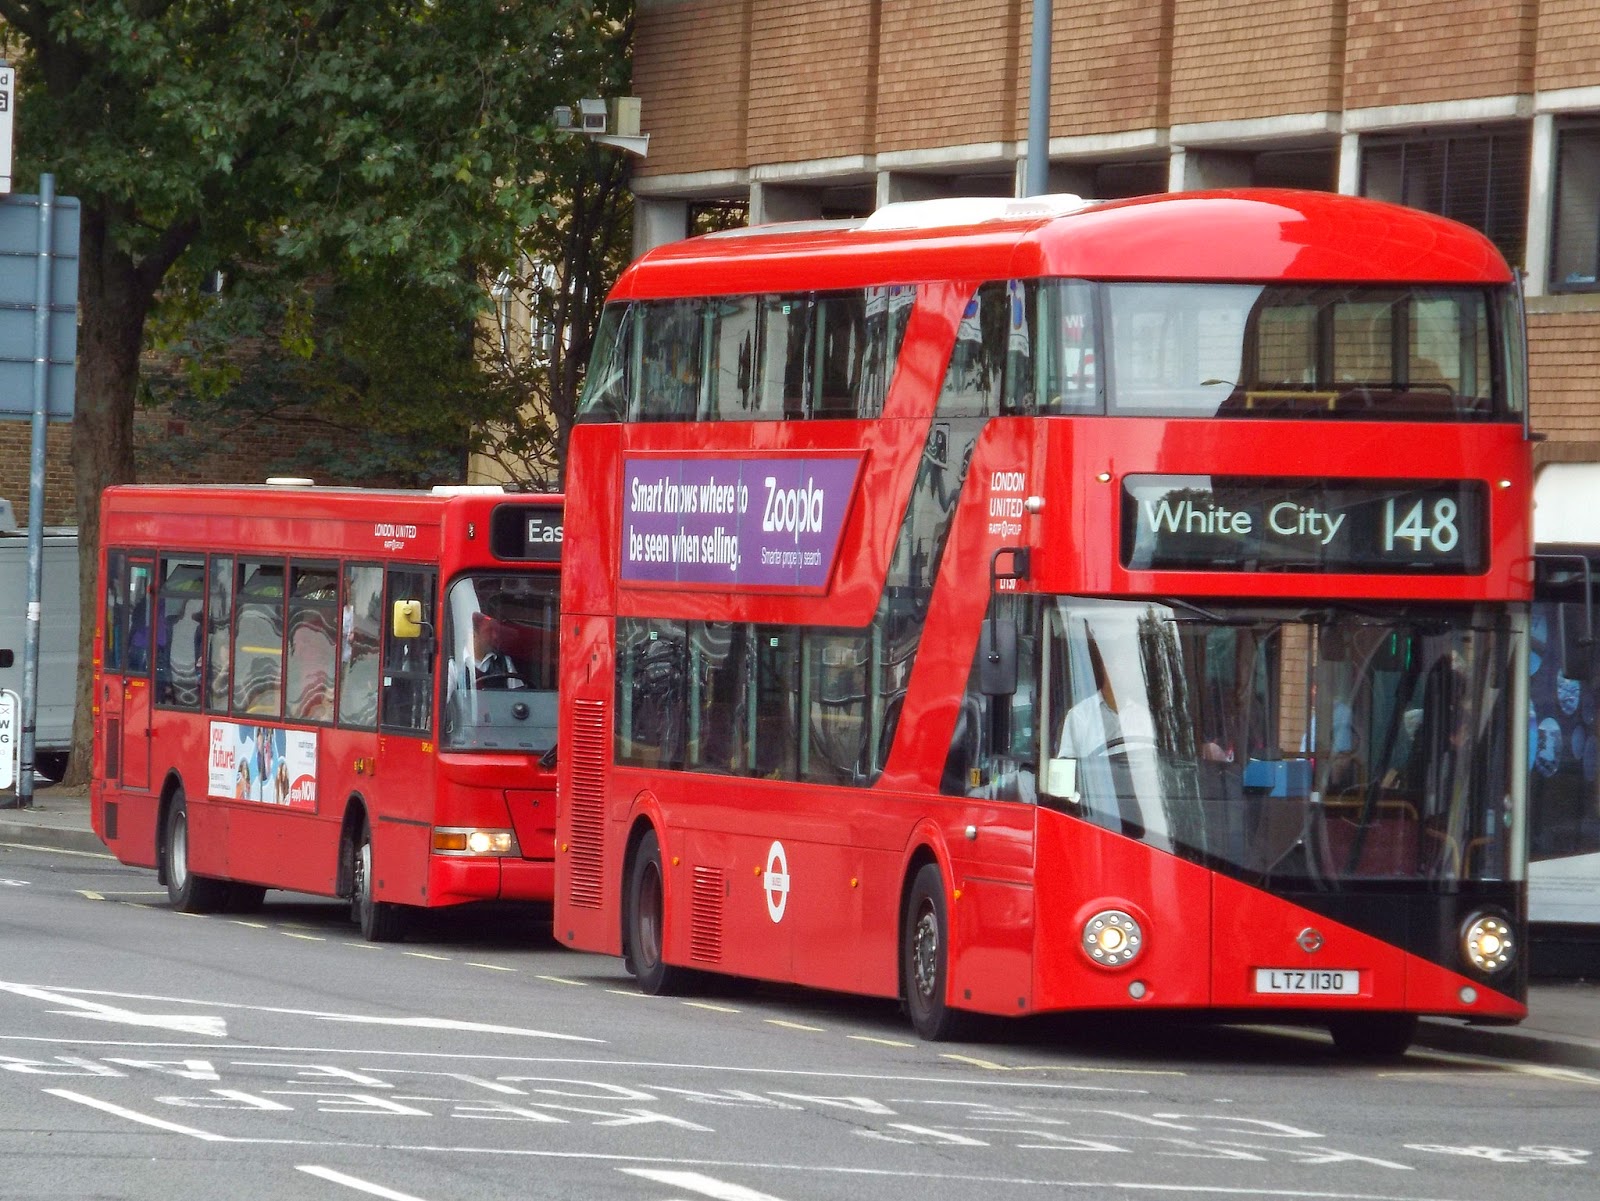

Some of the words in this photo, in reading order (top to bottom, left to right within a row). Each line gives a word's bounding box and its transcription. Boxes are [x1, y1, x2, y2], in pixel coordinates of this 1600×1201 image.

[991, 471, 1026, 492] LONDON
[631, 476, 663, 513] Smart
[664, 476, 698, 514] knows
[700, 476, 734, 514] where
[736, 479, 749, 514] to
[989, 498, 1023, 517] UNITED
[762, 476, 824, 544] Zoopla
[1147, 499, 1252, 535] White
[1268, 501, 1346, 545] City
[374, 523, 395, 537] LONDON
[395, 524, 417, 539] UNITED
[528, 518, 564, 543] Eas
[1385, 497, 1459, 552] 148
[629, 525, 643, 562] be
[645, 532, 669, 563] seen
[671, 526, 700, 564] when
[701, 527, 742, 571] selling.
[761, 546, 782, 565] Smarter
[782, 551, 803, 569] propey
[803, 548, 822, 566] search
[302, 780, 316, 802] NOW
[1271, 972, 1306, 990] LTZ
[1311, 973, 1344, 991] 1130
[153, 1088, 716, 1132] KEEP
